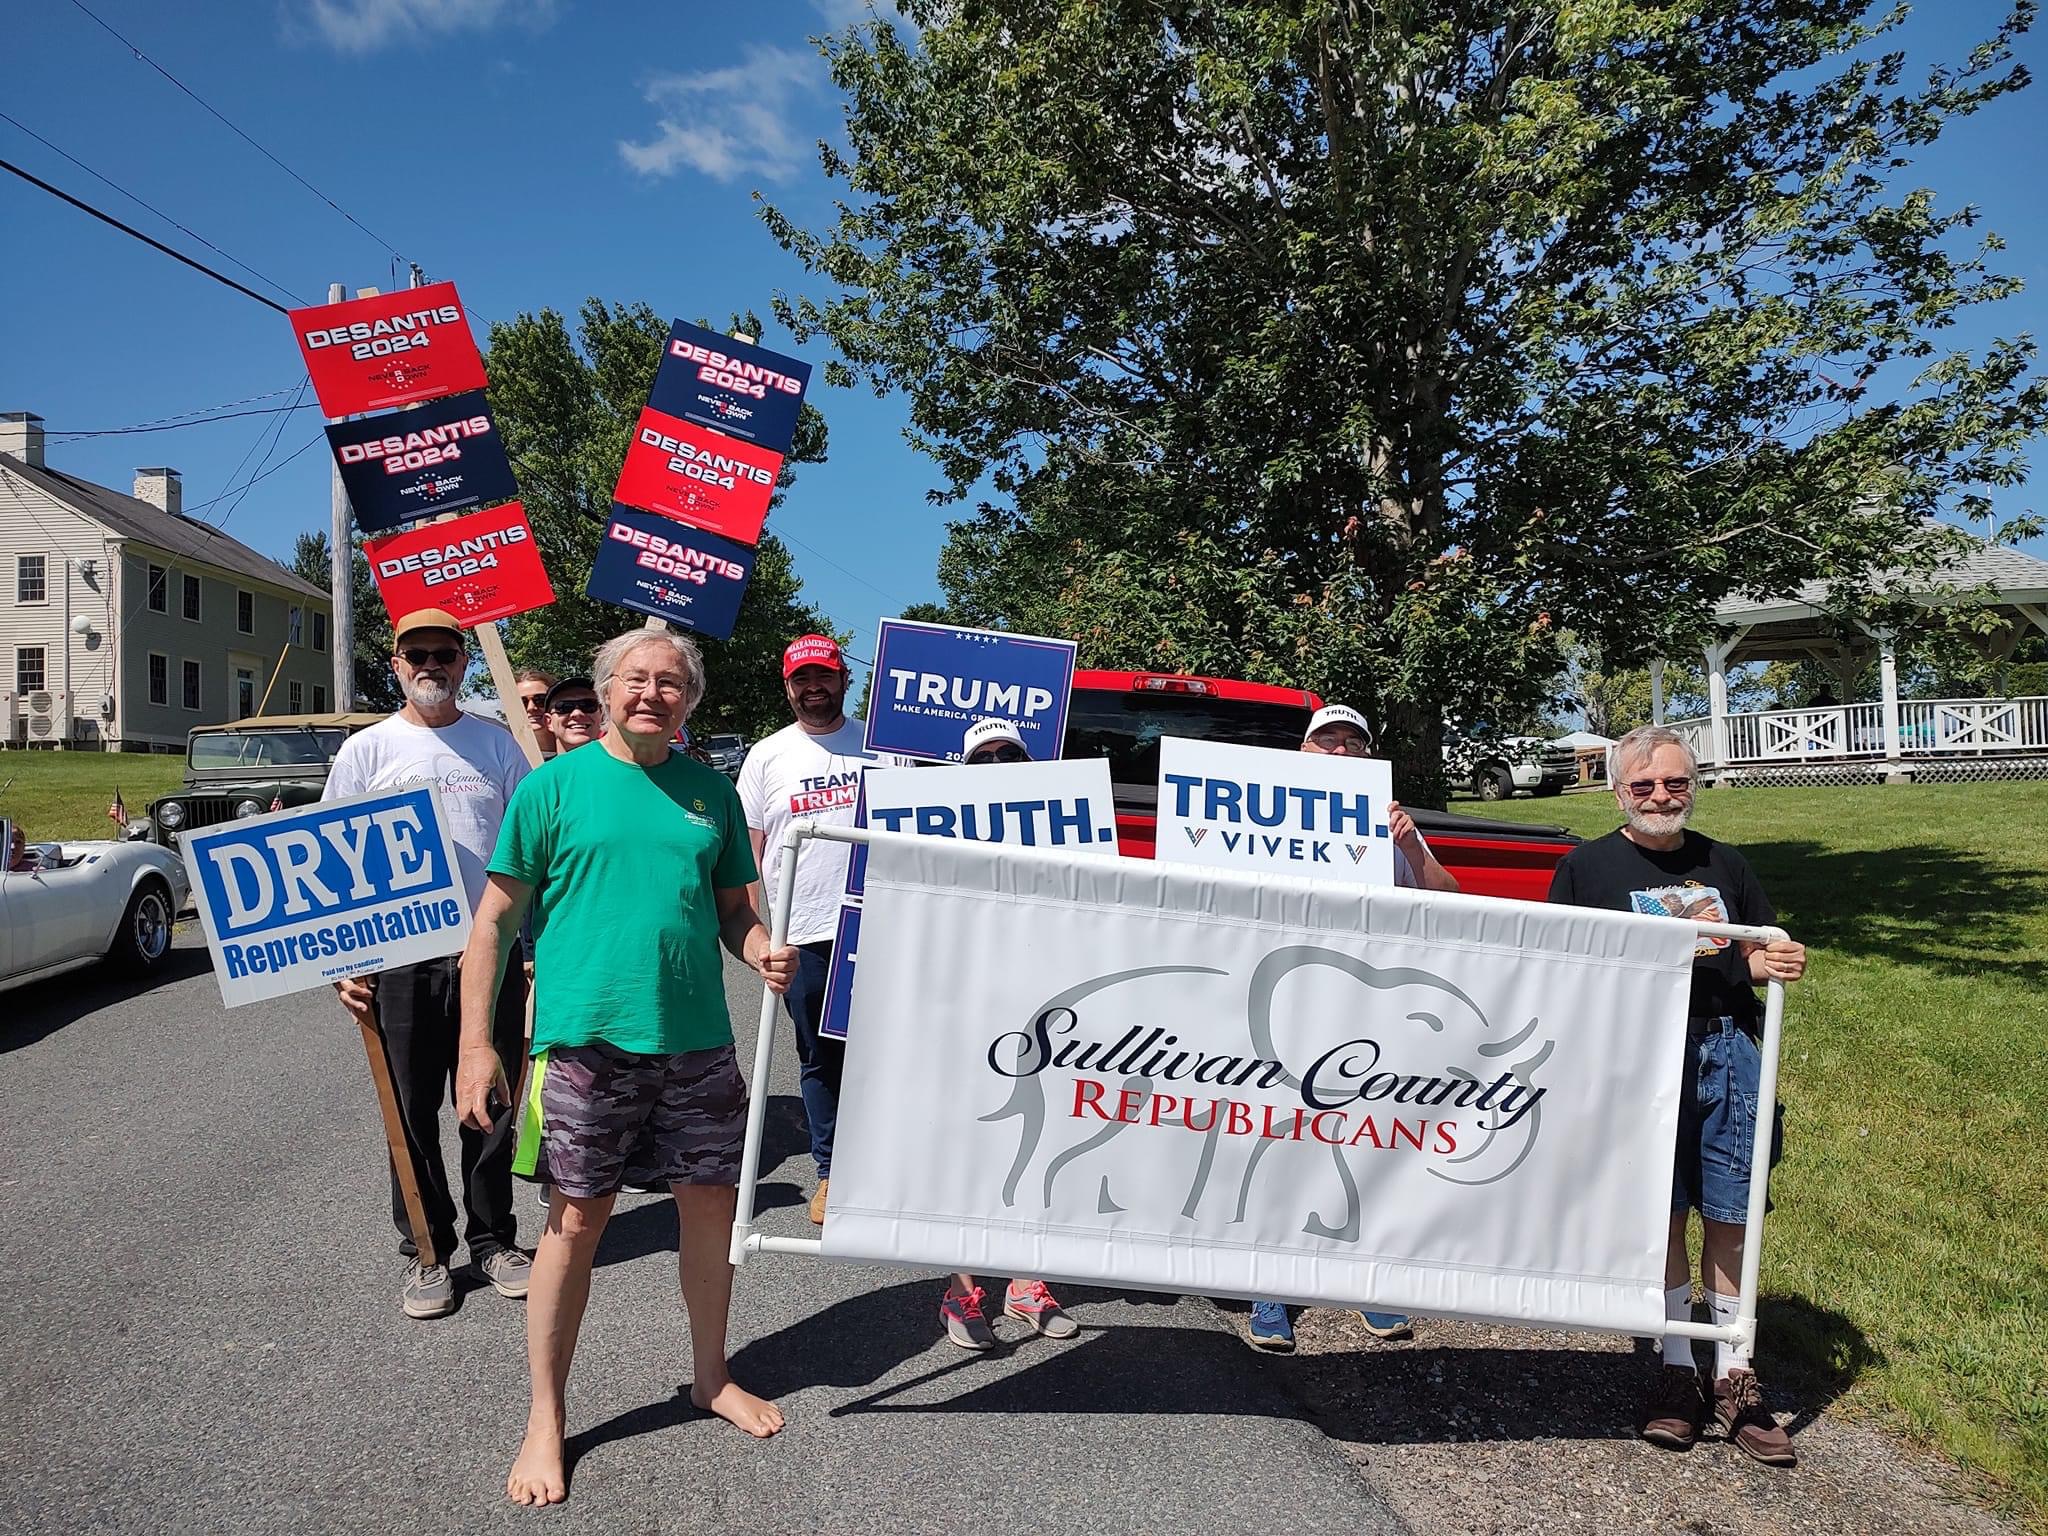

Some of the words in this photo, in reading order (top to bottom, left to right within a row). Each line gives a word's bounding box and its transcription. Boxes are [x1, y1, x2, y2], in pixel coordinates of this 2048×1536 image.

[305, 306, 460, 349] DESANTIS
[352, 331, 430, 360] 2024
[403, 364, 431, 374] BACK
[670, 339, 801, 395] DESANTIS
[697, 366, 766, 399] 2024
[729, 404, 753, 417] BACK
[339, 416, 490, 464] DESANTIS
[384, 442, 461, 475] 2024
[640, 428, 773, 486] DESANTIS
[400, 482, 434, 495] NEVER
[435, 475, 463, 487] BACK
[428, 482, 459, 495] DOWN
[668, 457, 734, 491] 2024
[378, 524, 527, 578] DESANTIS
[608, 522, 744, 581] DESANTIS
[423, 552, 498, 586] 2024
[636, 551, 707, 585] 2024
[636, 580, 668, 594] NEVER
[668, 591, 693, 603] BACK
[804, 639, 835, 649] AMERICA
[890, 668, 1053, 719] TRUMP
[893, 703, 921, 714] MAKE
[923, 708, 968, 721] AMERICA
[439, 784, 479, 794] LICANS
[445, 769, 490, 786] County
[800, 771, 858, 791] TEAM
[792, 787, 856, 812] TRUM
[1164, 774, 1389, 838] TRUTH.
[871, 798, 1113, 846] TRUTH.
[1220, 831, 1331, 864] VIVEK
[208, 805, 433, 930] DRYE
[222, 898, 461, 979] Representative
[321, 968, 336, 976] Paid
[353, 957, 384, 969] candidate
[987, 1007, 1289, 1090] Sullivan
[1300, 1038, 1547, 1131] County
[1068, 1077, 1459, 1155] REPUBLICANS
